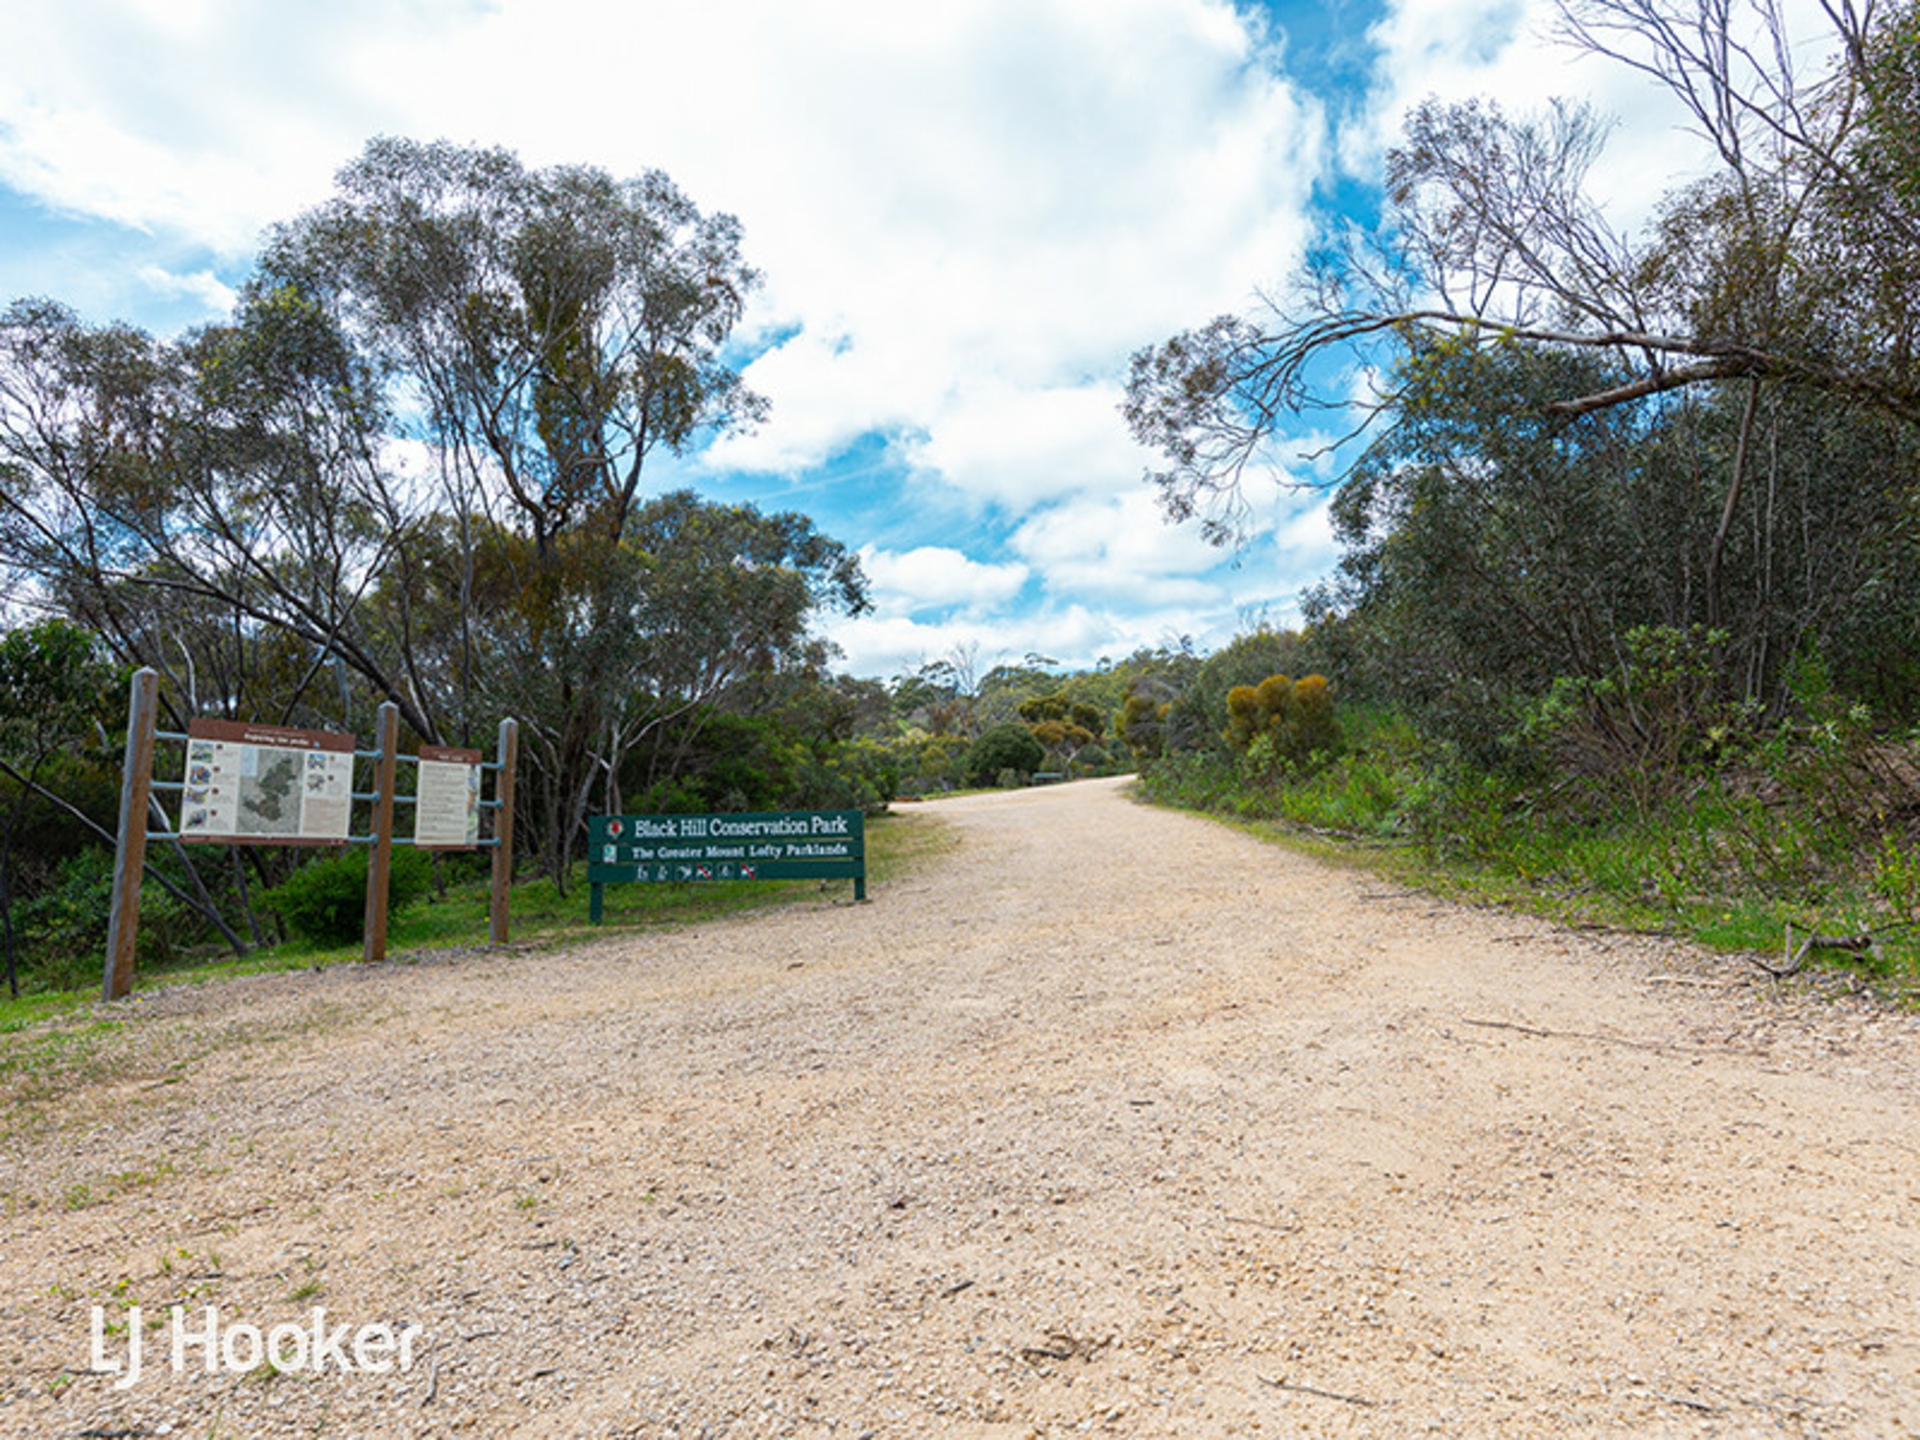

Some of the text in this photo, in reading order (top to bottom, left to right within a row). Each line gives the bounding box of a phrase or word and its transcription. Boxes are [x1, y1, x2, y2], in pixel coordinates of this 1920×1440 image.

[634, 816, 848, 838] Black Hill Conservation Park
[632, 844, 848, 859] The Greater Mount Lofty Parklands
